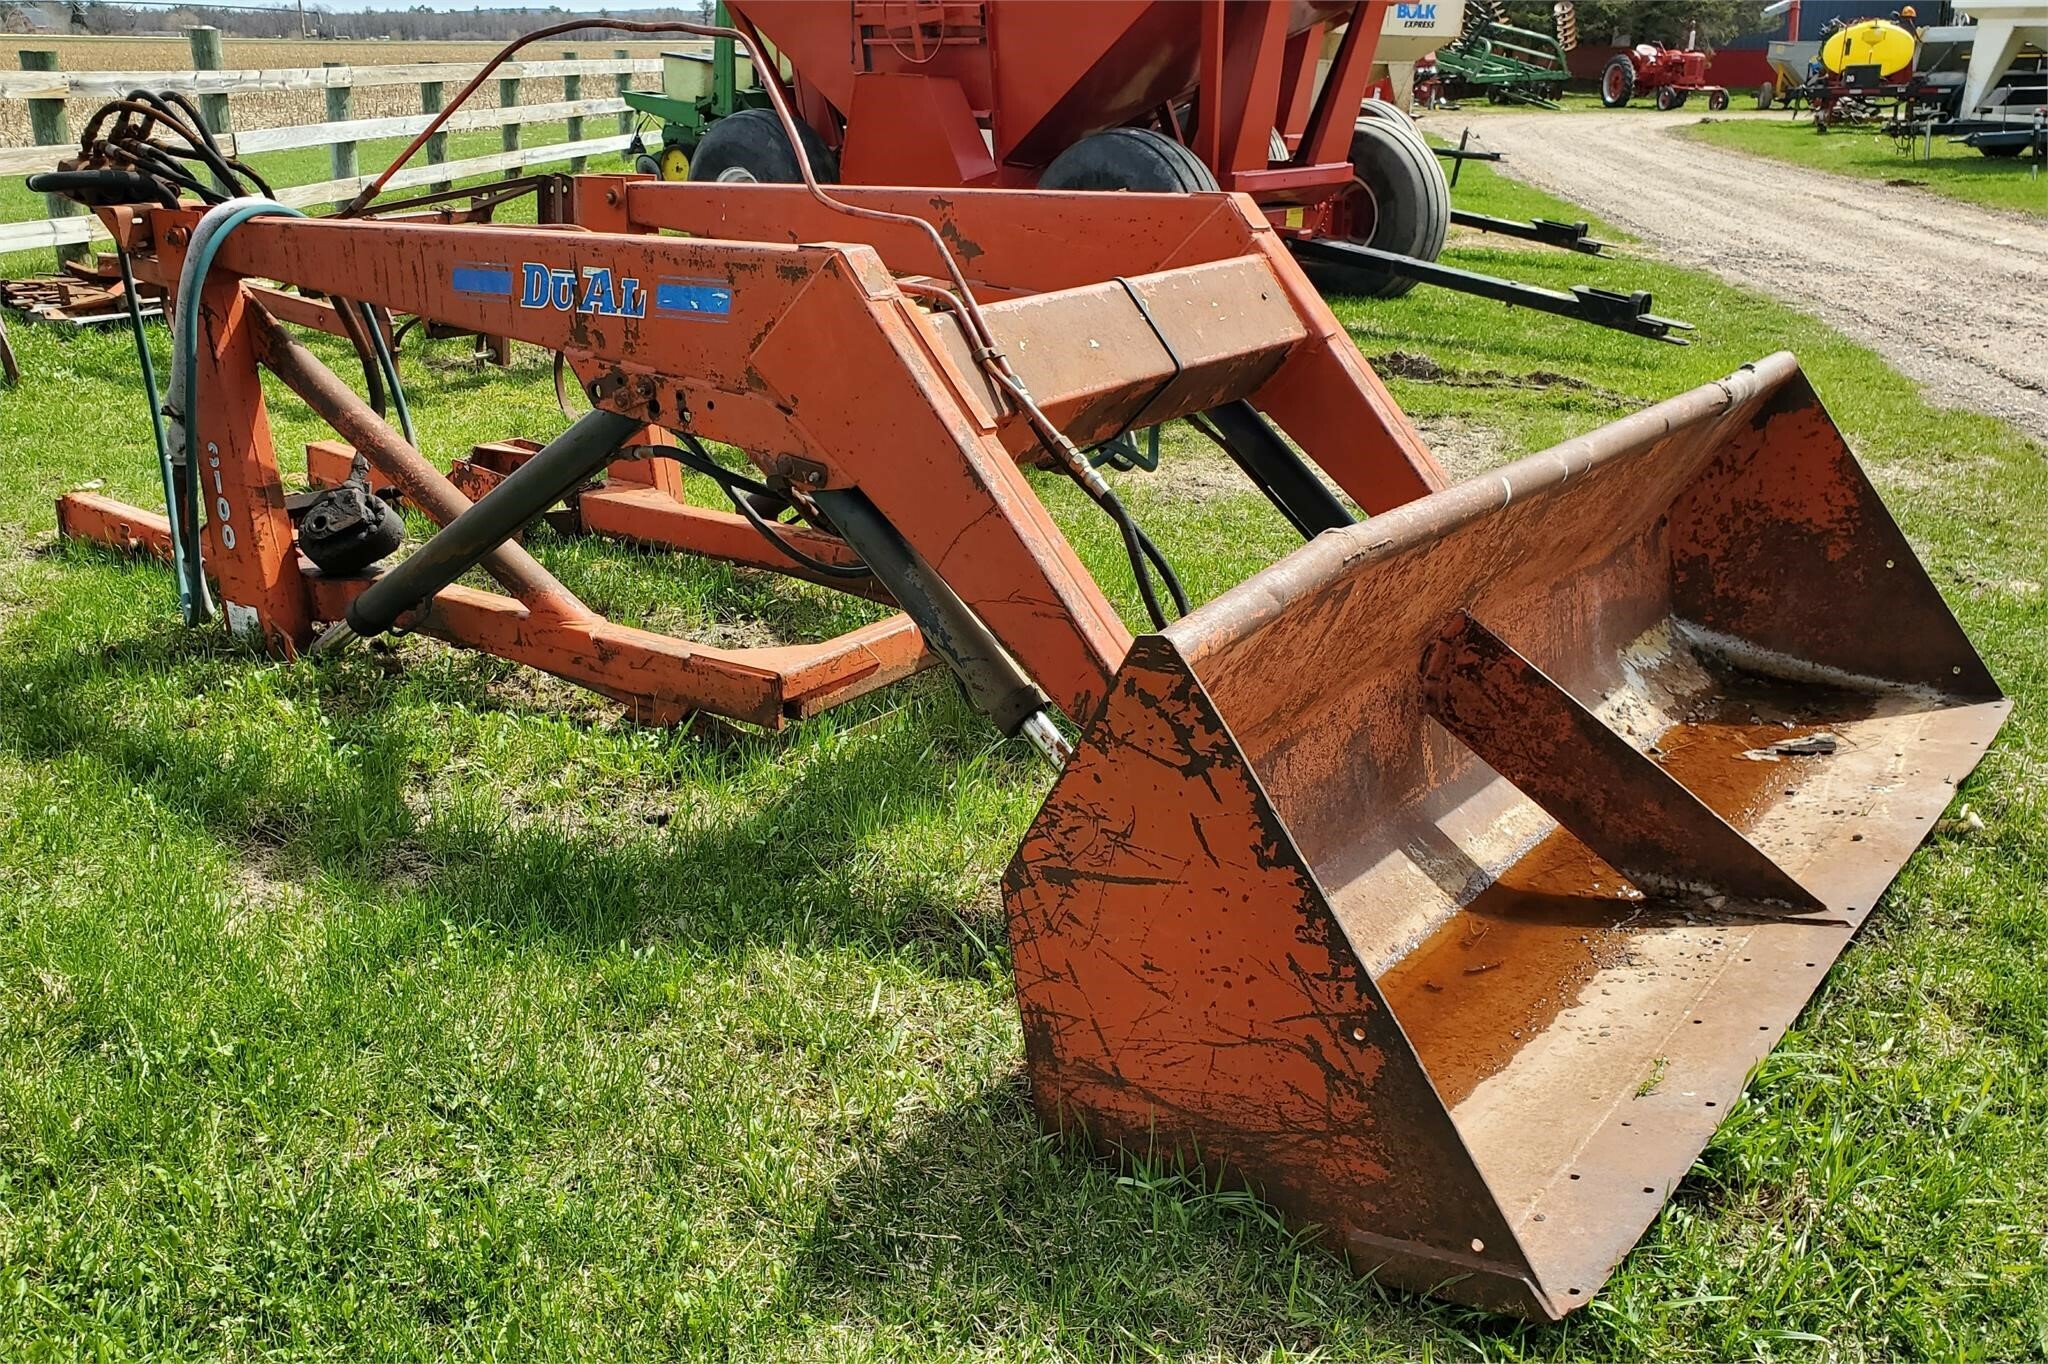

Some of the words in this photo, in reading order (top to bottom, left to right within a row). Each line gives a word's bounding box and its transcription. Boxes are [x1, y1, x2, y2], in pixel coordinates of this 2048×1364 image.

[1396, 3, 1437, 20] BULK
[1403, 20, 1436, 29] EXPRESS
[520, 261, 648, 319] DUAL
[207, 441, 236, 550] 3100
